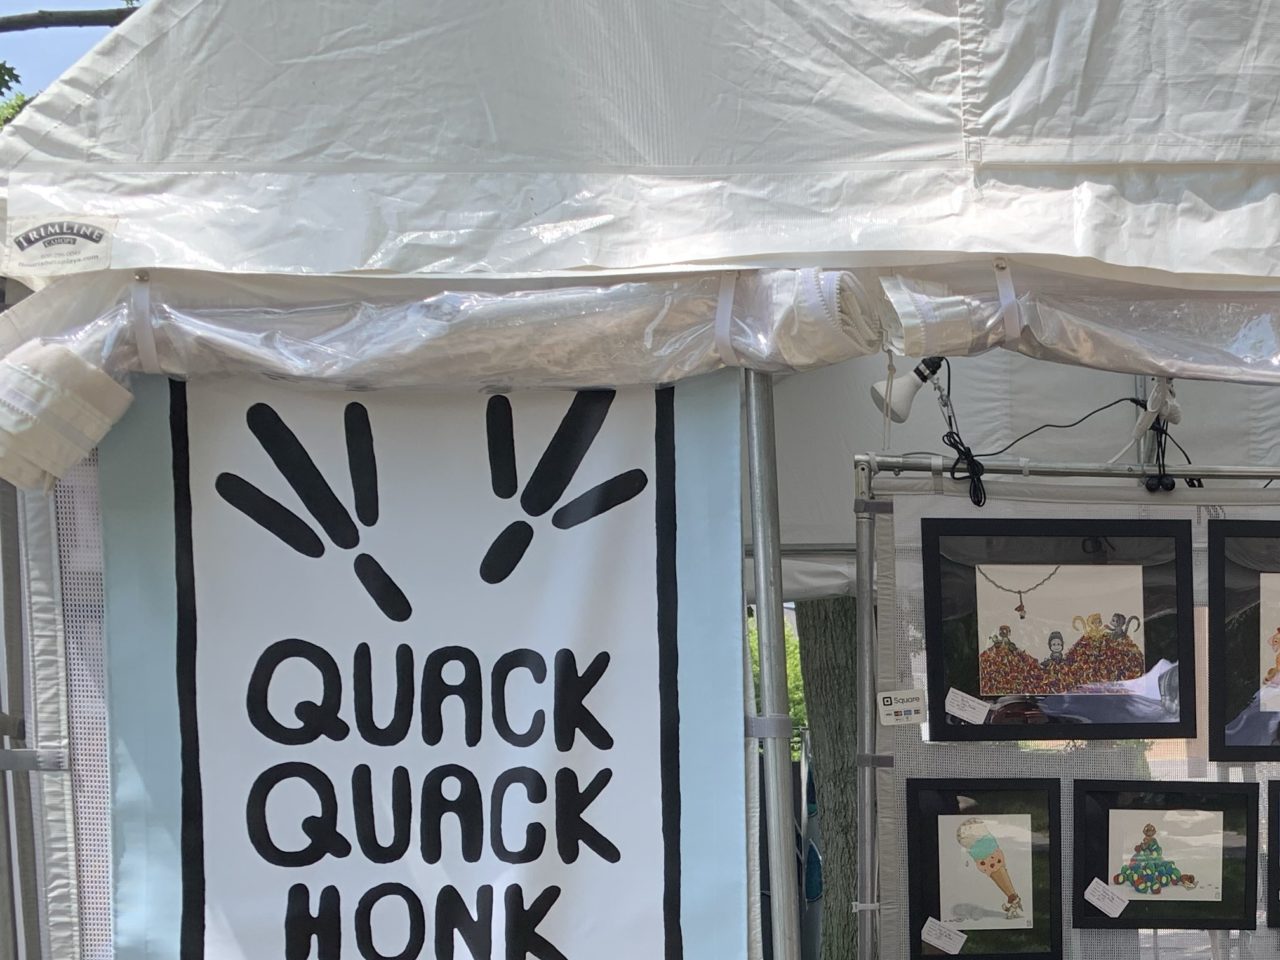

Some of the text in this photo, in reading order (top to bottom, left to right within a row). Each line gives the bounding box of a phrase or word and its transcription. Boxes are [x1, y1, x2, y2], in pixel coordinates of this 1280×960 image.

[16, 222, 103, 247] TRIMLINE
[246, 638, 614, 752] QUACK
[246, 761, 621, 868] QUACK
